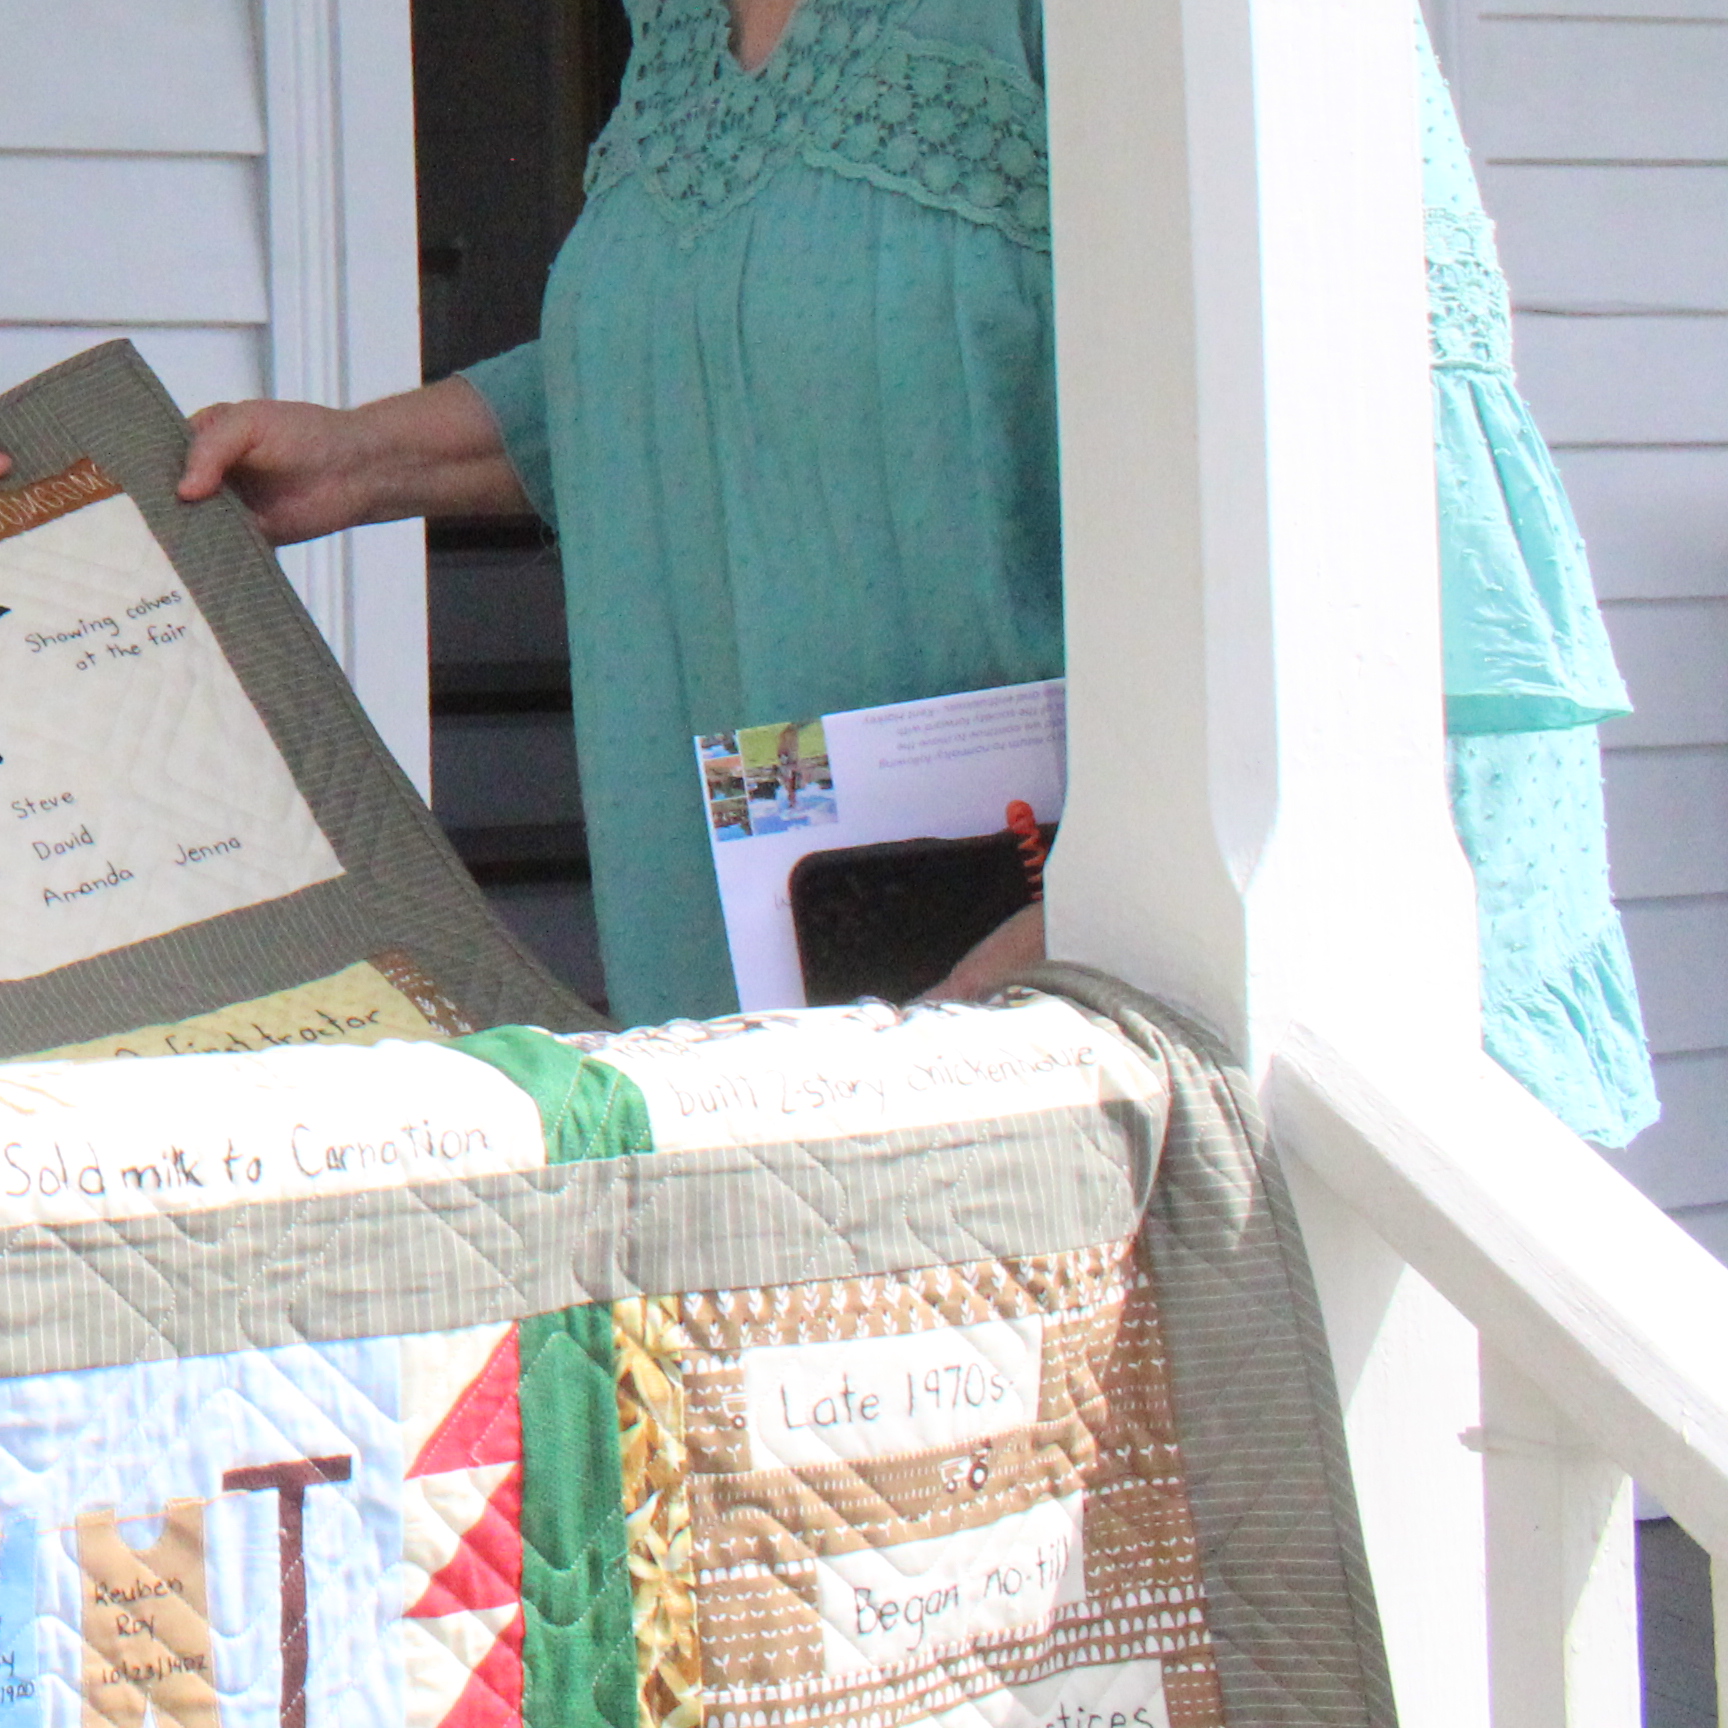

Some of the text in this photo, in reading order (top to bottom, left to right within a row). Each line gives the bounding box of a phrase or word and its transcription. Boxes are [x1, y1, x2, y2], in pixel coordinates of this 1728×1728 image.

[24, 589, 183, 654] Showing calves
[75, 622, 188, 672] at the fair
[10, 789, 77, 820] Steve
[31, 823, 96, 862] David
[173, 836, 243, 868] Jenna
[43, 860, 136, 907] Amanda
[250, 1008, 381, 1046] tractor
[667, 1072, 760, 1117] built
[3, 1120, 492, 1198] Sold milk to Carnation
[781, 1372, 880, 1430] Late
[94, 1576, 184, 1607] Reuben
[115, 1612, 156, 1638] Roy
[853, 1585, 961, 1651] Began
